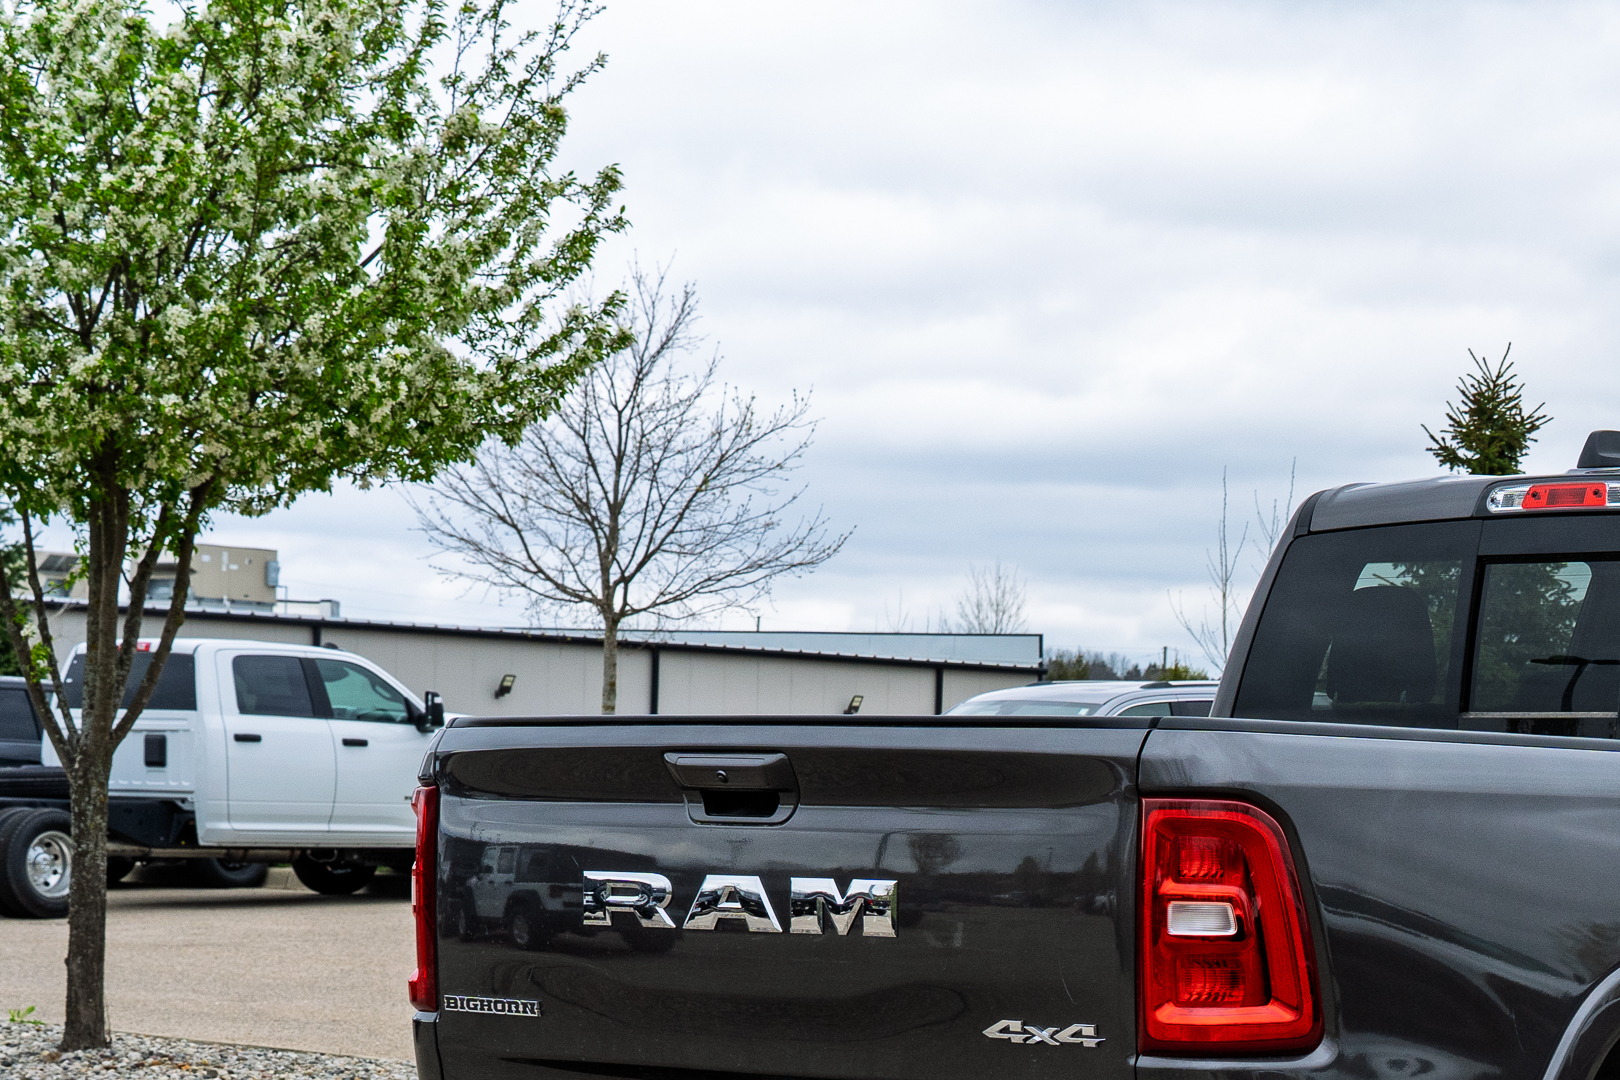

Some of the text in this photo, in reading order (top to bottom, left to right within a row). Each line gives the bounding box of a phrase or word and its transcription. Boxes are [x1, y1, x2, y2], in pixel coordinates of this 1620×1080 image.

[583, 870, 898, 938] RAM
[444, 995, 539, 1017] BIGHORN
[982, 1019, 1106, 1048] 4x4
